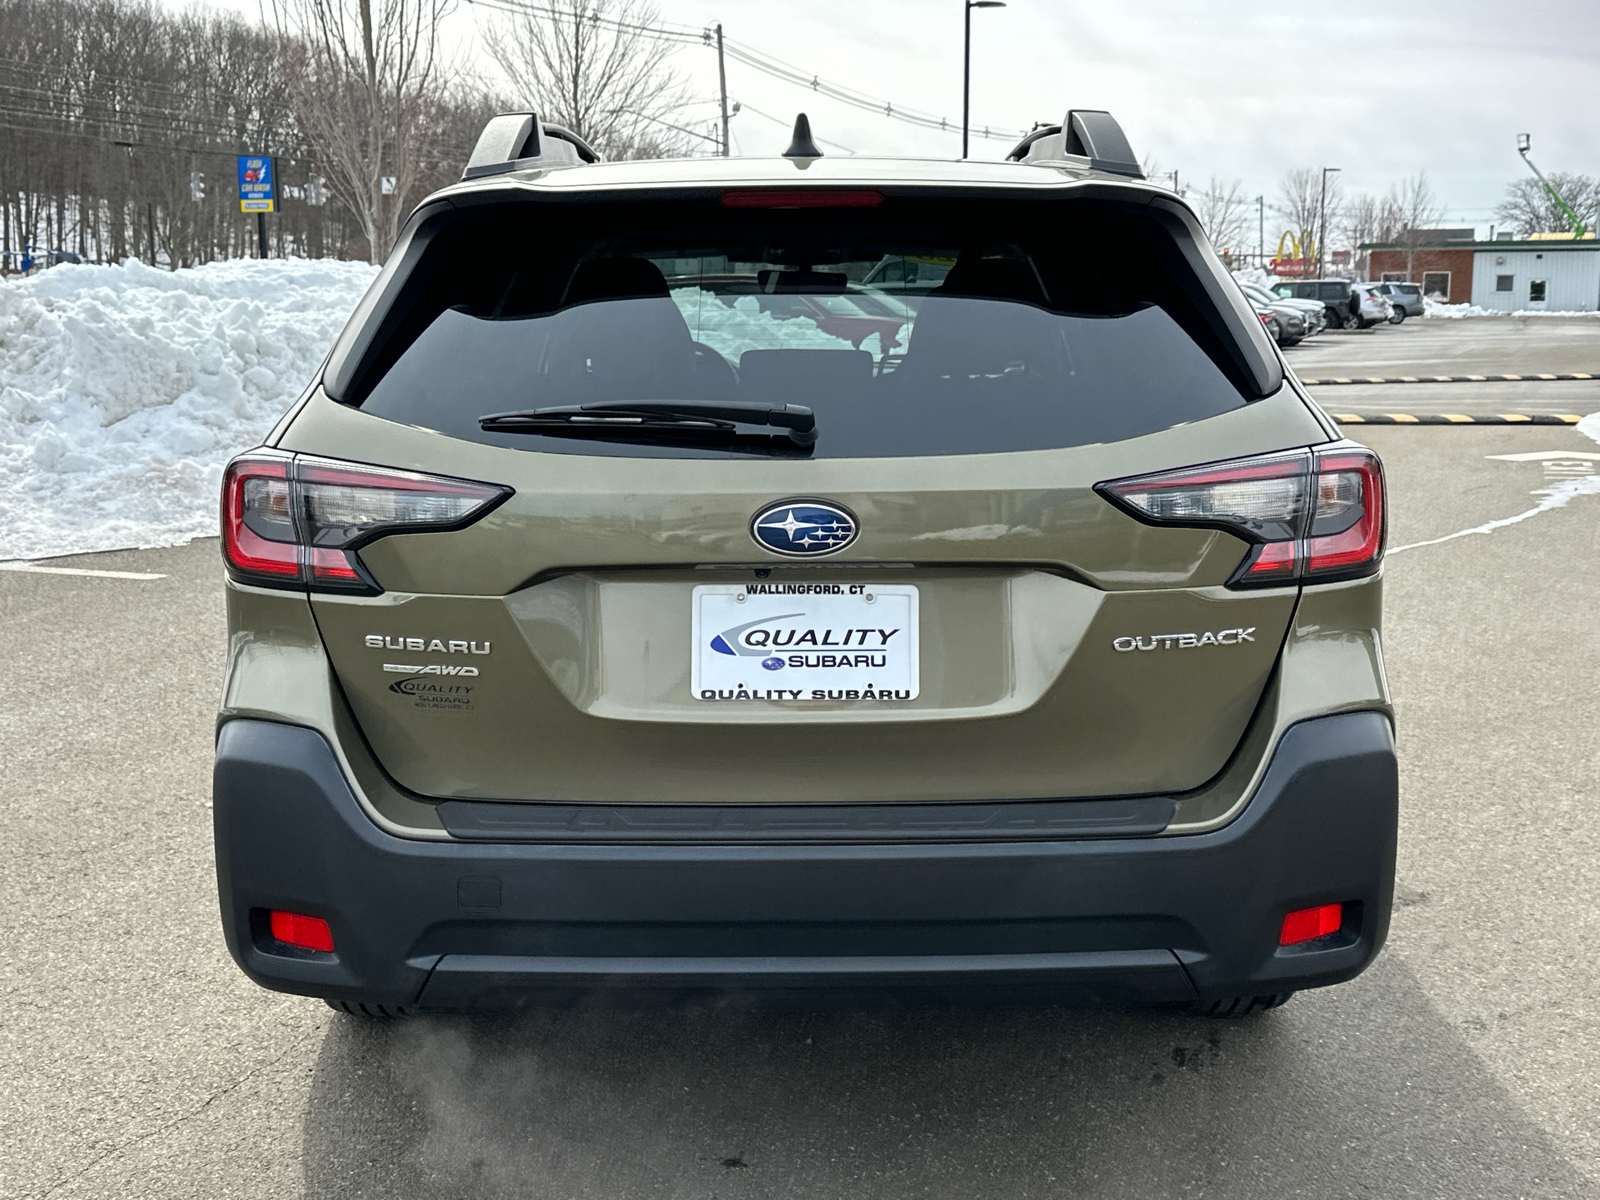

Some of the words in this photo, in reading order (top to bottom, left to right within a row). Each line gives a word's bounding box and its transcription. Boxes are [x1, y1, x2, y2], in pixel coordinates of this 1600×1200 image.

[746, 584, 845, 595] WALLINGFORD,
[849, 584, 866, 595] CT
[744, 629, 901, 647] QUALITY
[1113, 627, 1256, 652] OUTBACK
[364, 634, 491, 655] SUBARU
[788, 655, 887, 668] SUBARU
[418, 665, 479, 677] AWD
[403, 682, 474, 694] QUALITY
[418, 695, 470, 704] SUBARU
[701, 689, 803, 700] QUALITY
[811, 689, 911, 700] SUBARU
